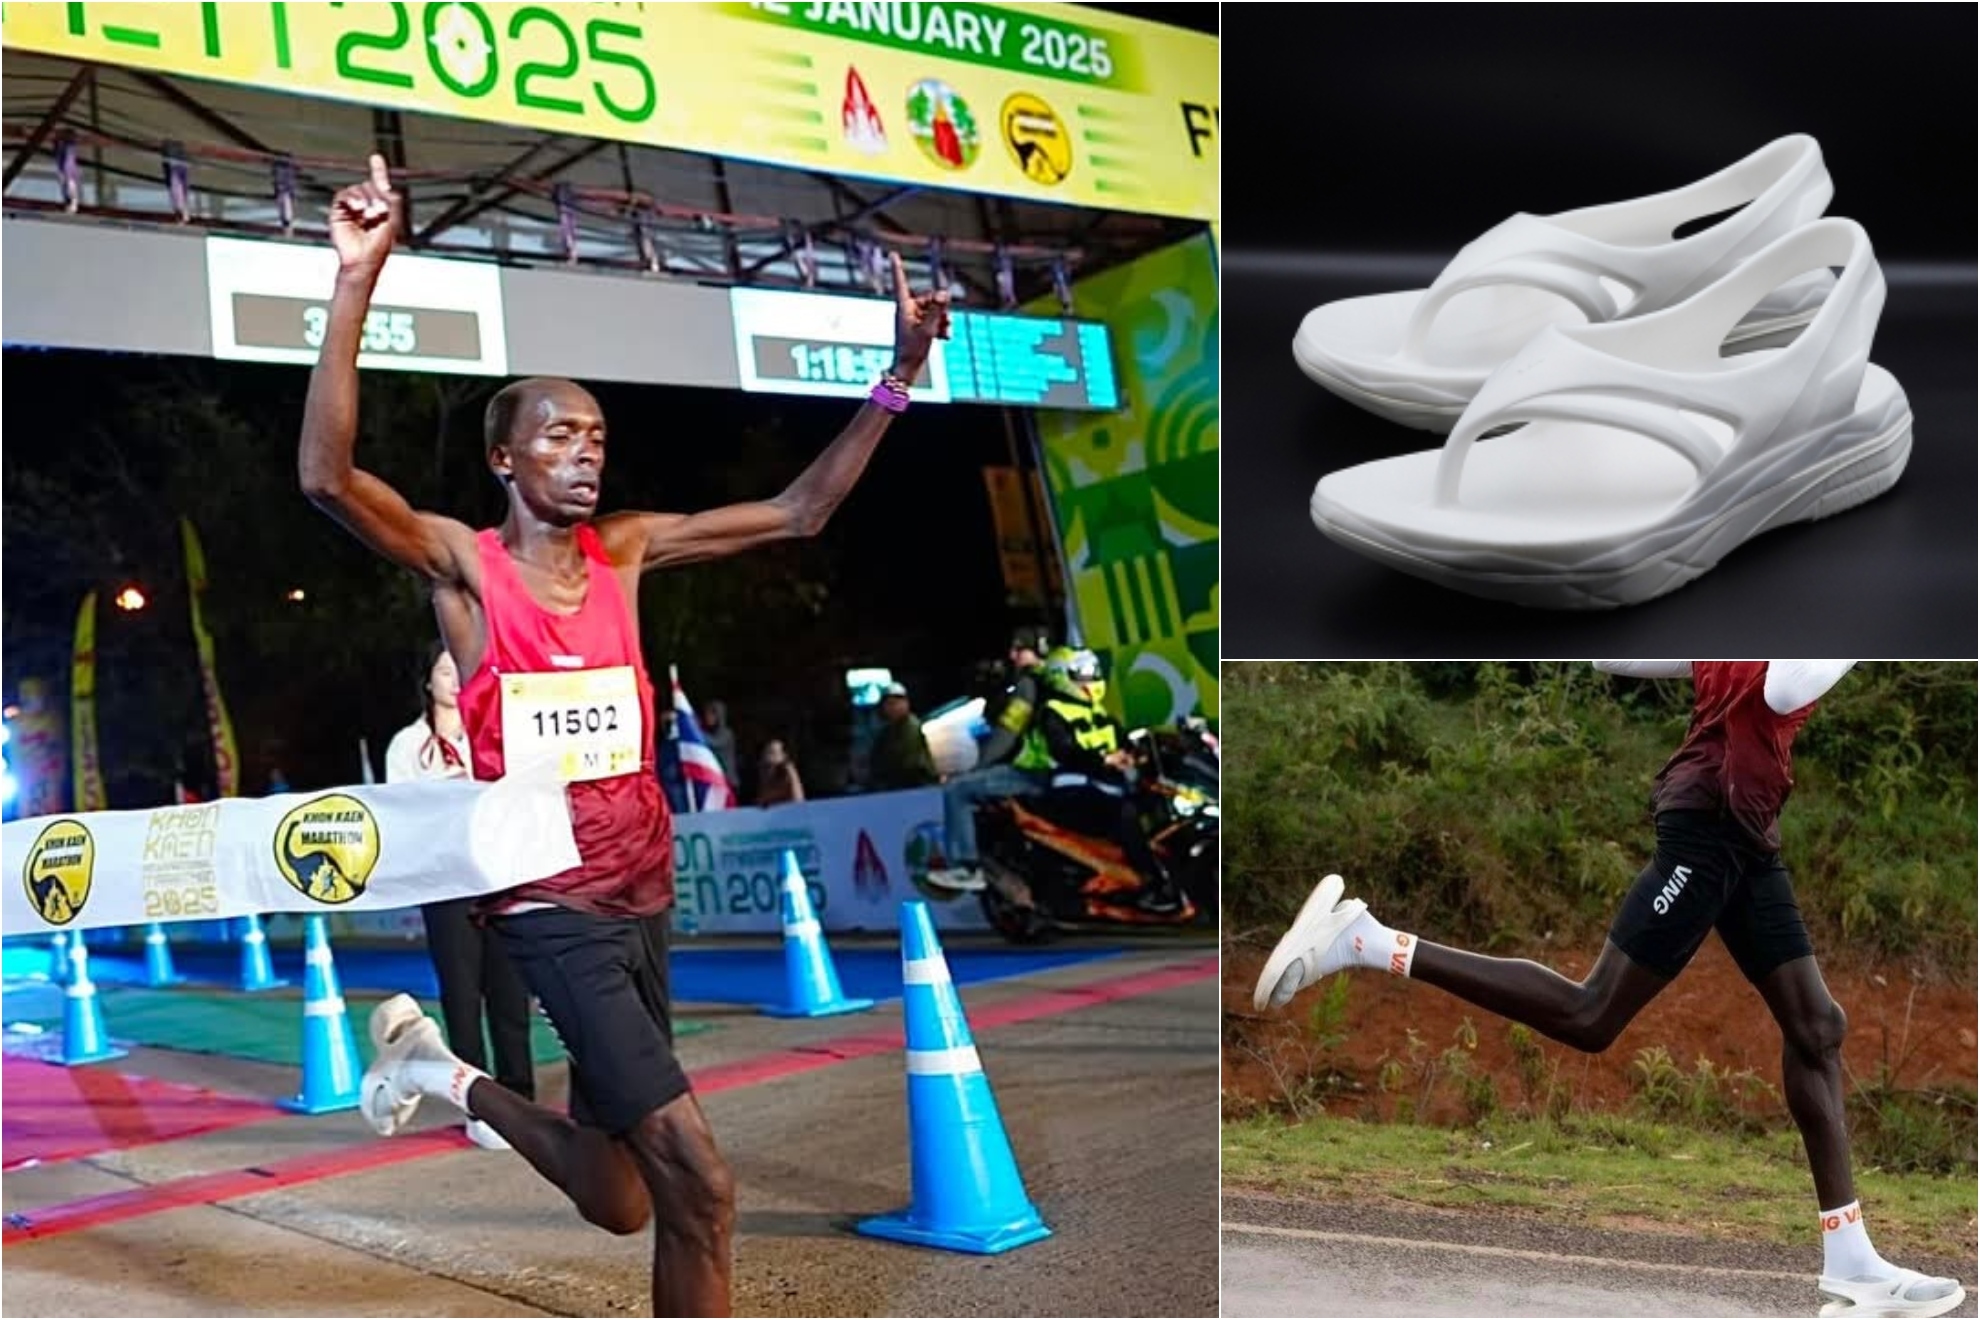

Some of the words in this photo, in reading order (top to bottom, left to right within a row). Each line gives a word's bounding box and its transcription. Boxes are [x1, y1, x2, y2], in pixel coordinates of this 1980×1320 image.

[335, 1, 656, 122] 2025
[1020, 23, 1112, 77] 2025
[1181, 101, 1219, 158] F
[532, 704, 618, 737] 11502
[303, 811, 333, 823] KHON
[335, 809, 364, 822] KAEN
[301, 830, 362, 845] MARATHON
[42, 853, 82, 869] MARATHON
[144, 885, 219, 917] 2025
